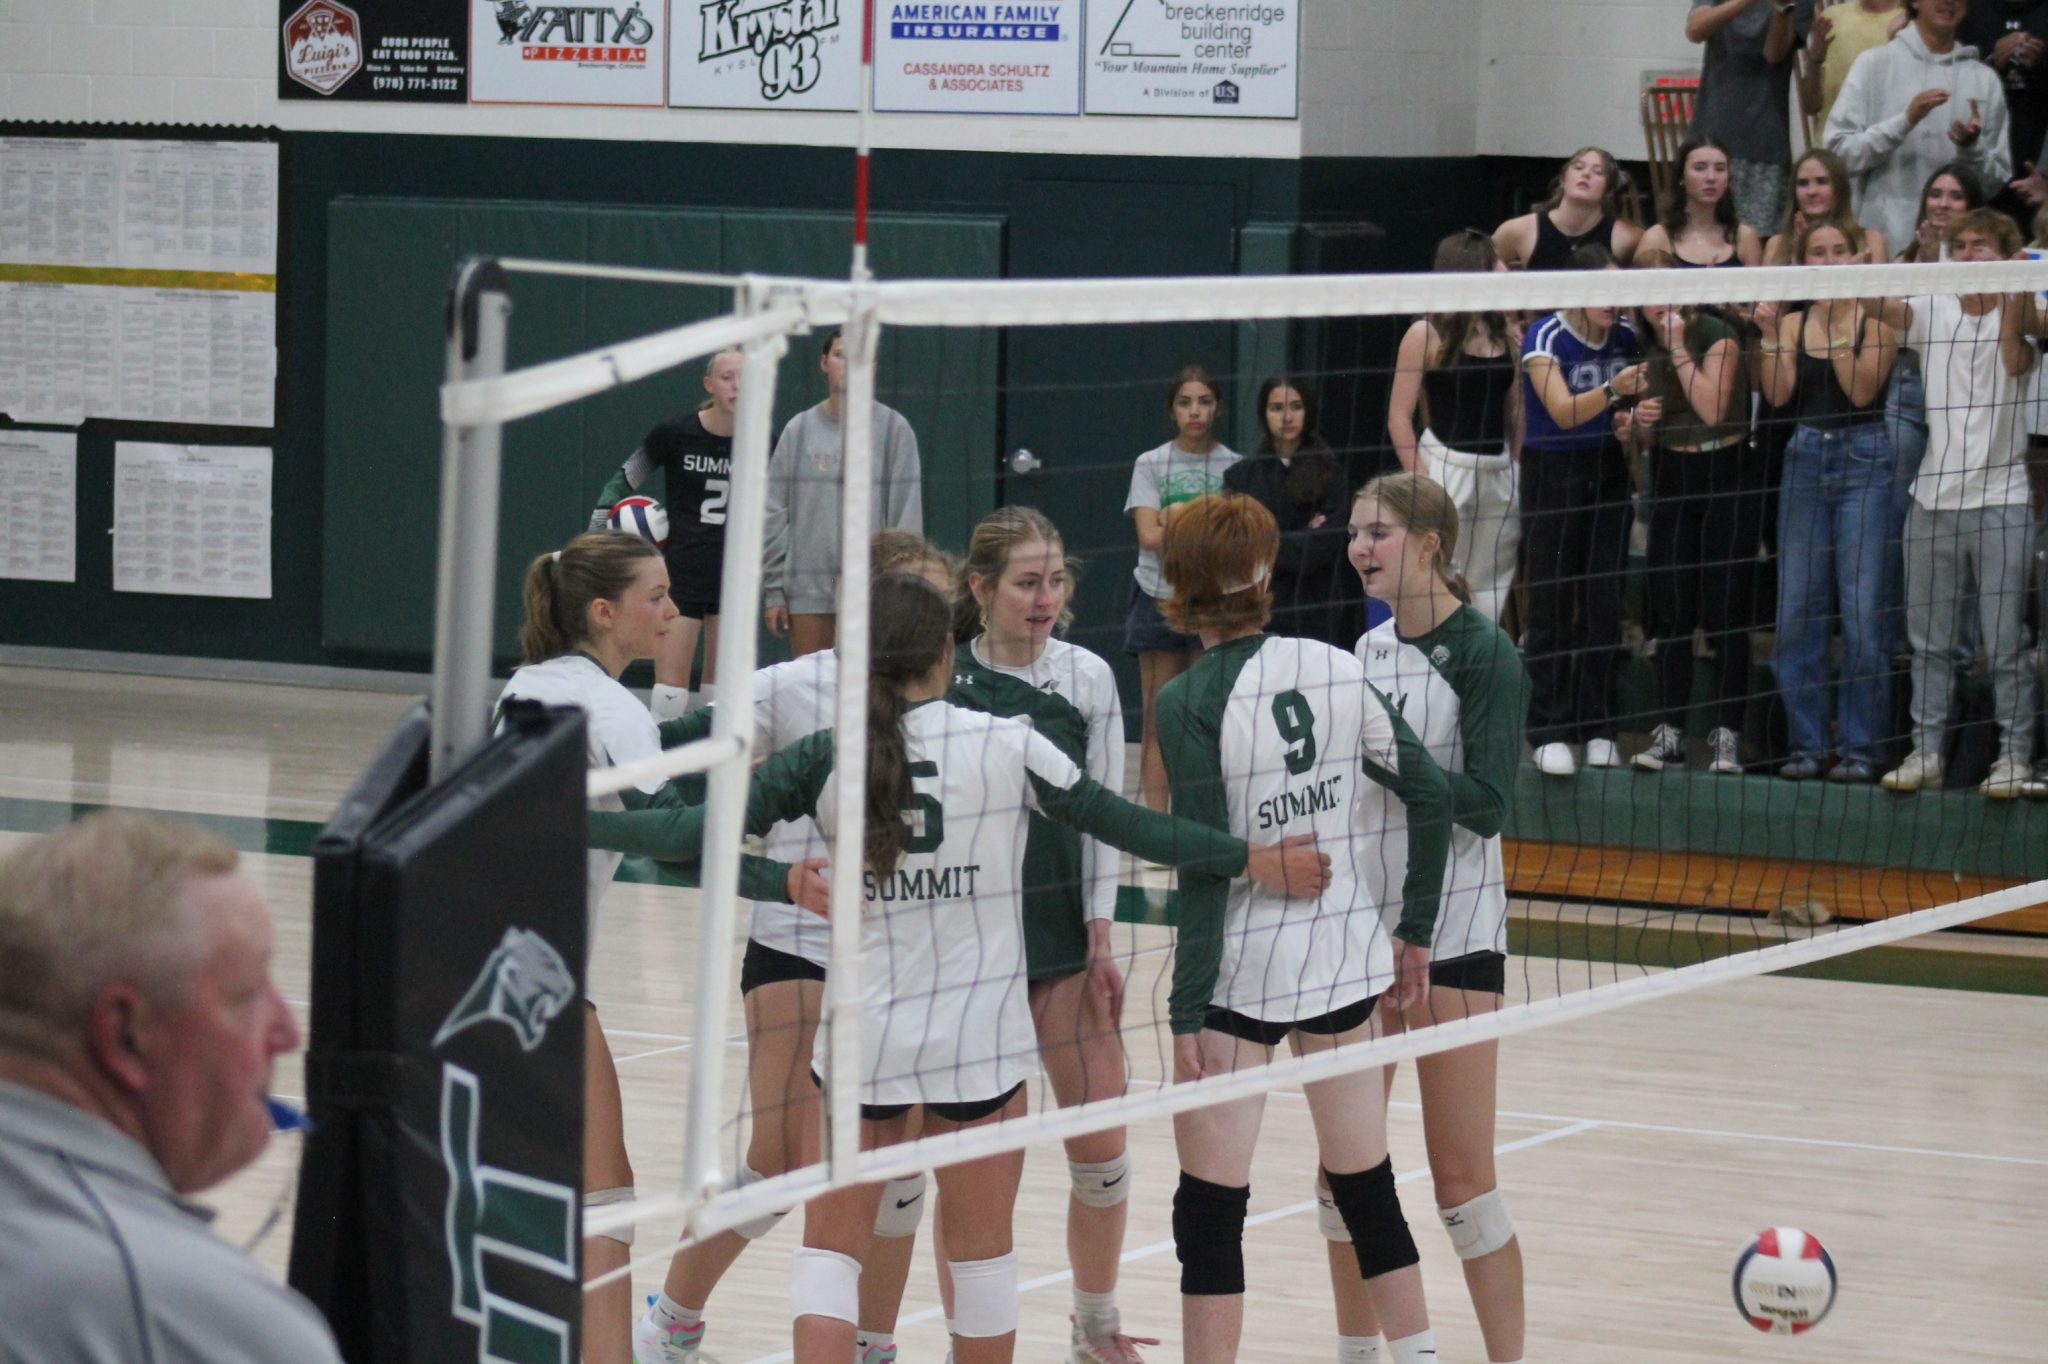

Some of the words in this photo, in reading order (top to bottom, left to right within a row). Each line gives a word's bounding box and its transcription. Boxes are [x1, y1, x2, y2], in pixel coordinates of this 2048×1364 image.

[891, 4, 986, 21] AMERICAN
[994, 6, 1059, 22] FAMILY
[1165, 4, 1285, 26] breckenridge
[698, 0, 839, 63] Krystal
[903, 25, 1047, 39] INSURANCE
[1181, 22, 1252, 45] building
[381, 37, 409, 48] GOOD
[411, 37, 450, 49] PEOPLE
[1194, 43, 1252, 59] center
[297, 43, 351, 69] Luigi's
[372, 49, 391, 60] EAT
[393, 50, 421, 60] GOOD
[424, 50, 459, 61] PIZZA.
[530, 47, 637, 61] PIZZERIA
[759, 33, 821, 101] 93
[903, 63, 985, 76] CASSANDRA
[989, 65, 1050, 77] SCHULTZ
[1131, 62, 1188, 74] Mountain
[1192, 63, 1226, 75] Home
[928, 78, 937, 91] &
[941, 79, 1024, 92] ASSOCIATES
[1153, 88, 1195, 97] Division
[682, 454, 733, 475] SUMM
[700, 478, 730, 525] 2
[1271, 689, 1317, 776] 9
[863, 864, 981, 902] SUMMIT
